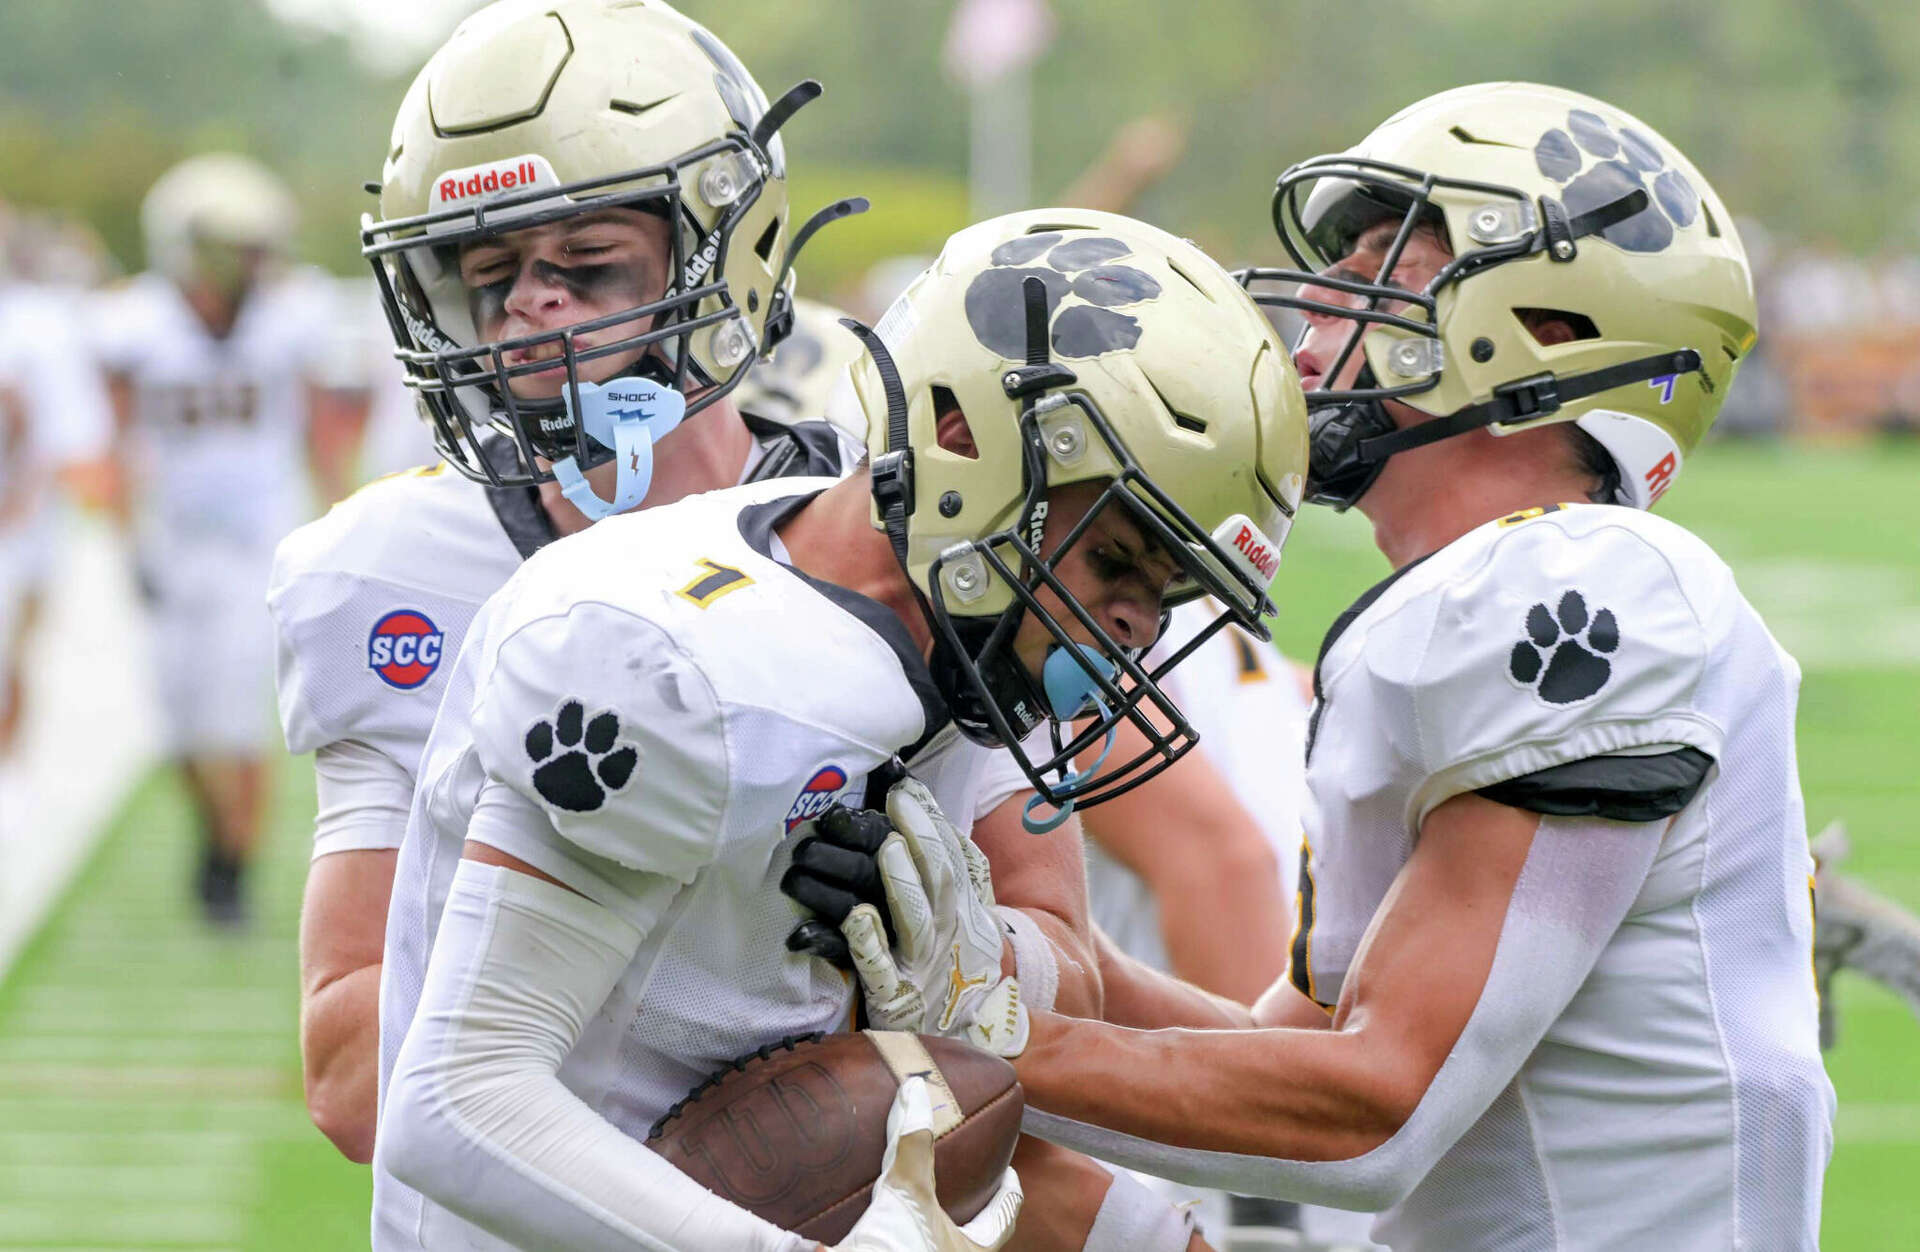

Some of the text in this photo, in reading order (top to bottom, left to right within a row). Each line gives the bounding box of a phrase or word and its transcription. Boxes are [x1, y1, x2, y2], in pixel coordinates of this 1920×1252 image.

[440, 161, 536, 202] Riddell
[608, 392, 657, 402] SHOCK
[540, 416, 573, 431] Ridd
[371, 634, 442, 666] SCC
